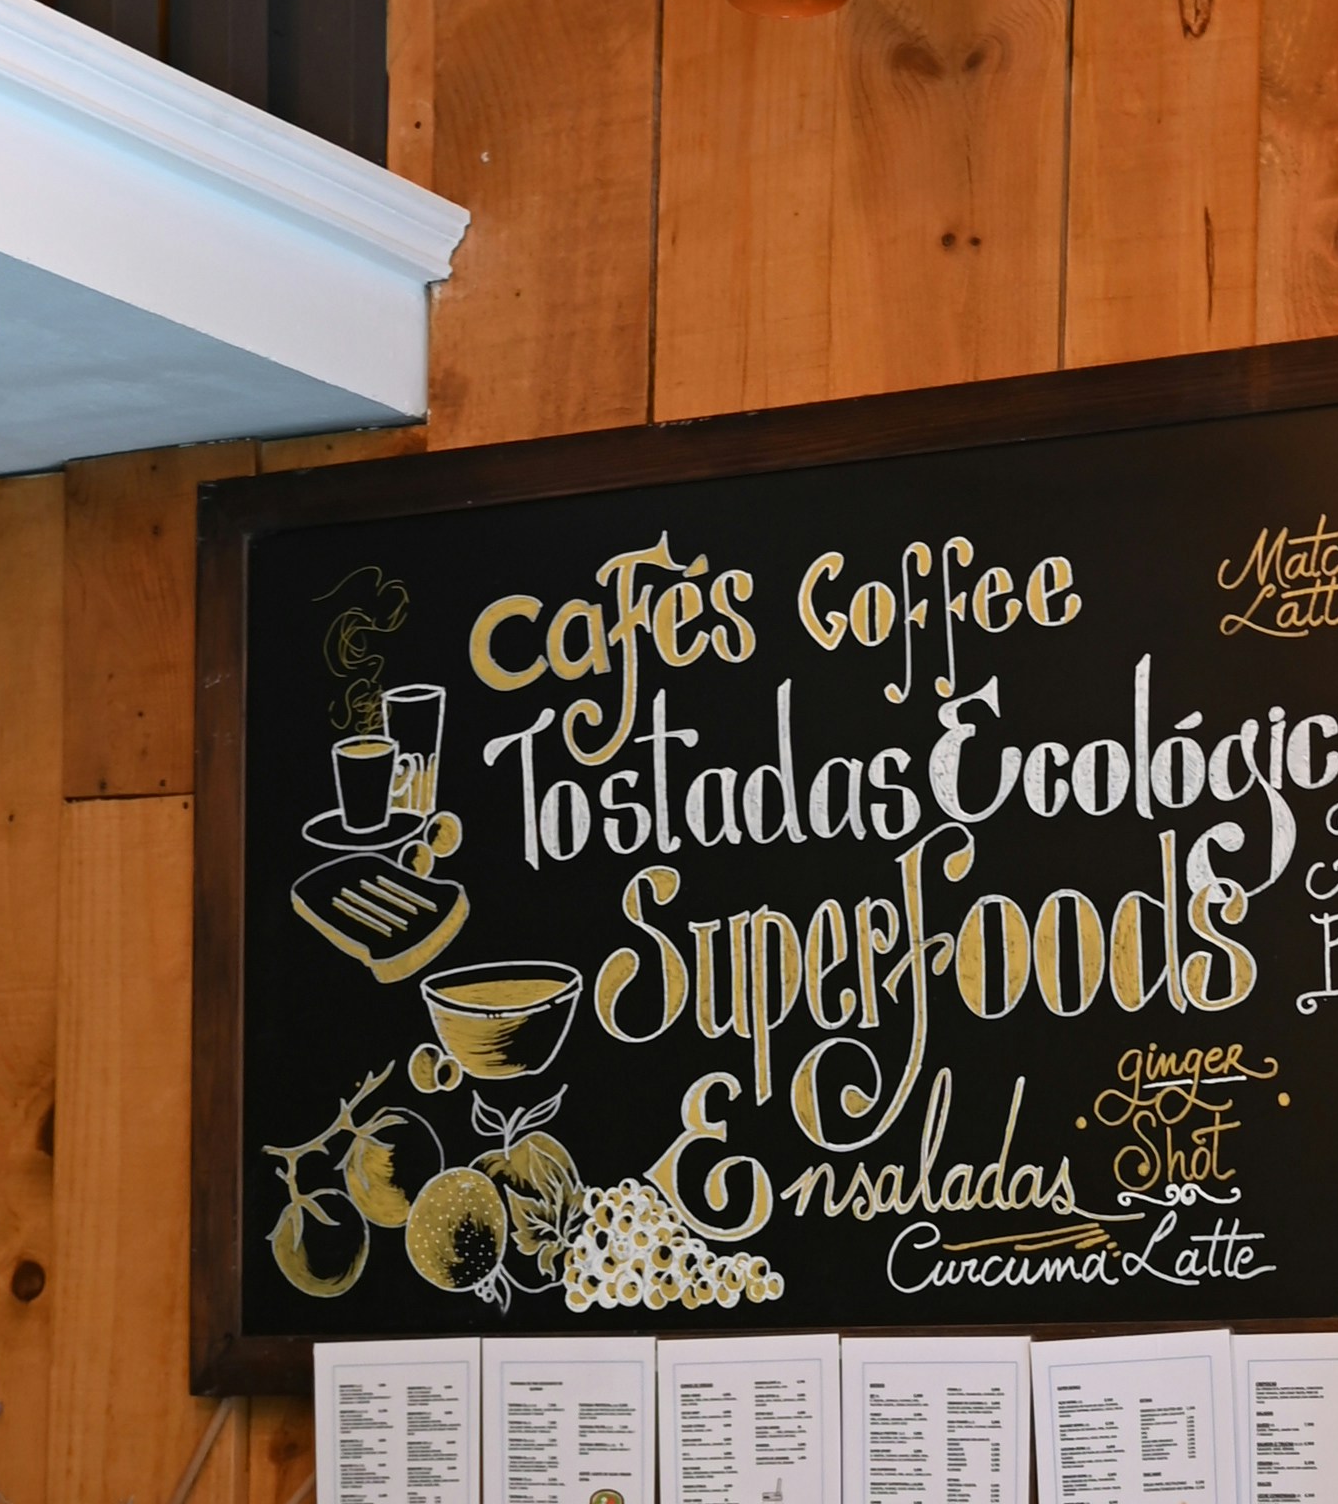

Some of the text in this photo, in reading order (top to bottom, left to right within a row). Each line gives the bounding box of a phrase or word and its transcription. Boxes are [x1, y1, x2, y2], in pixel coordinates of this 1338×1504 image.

[798, 536, 1082, 704] Coffee
[483, 678, 921, 871] Tostadas
[644, 1067, 1145, 1242] Ensaladas
[1114, 1110, 1240, 1192] Shot
[887, 1210, 1276, 1294] Curcuma Latte
